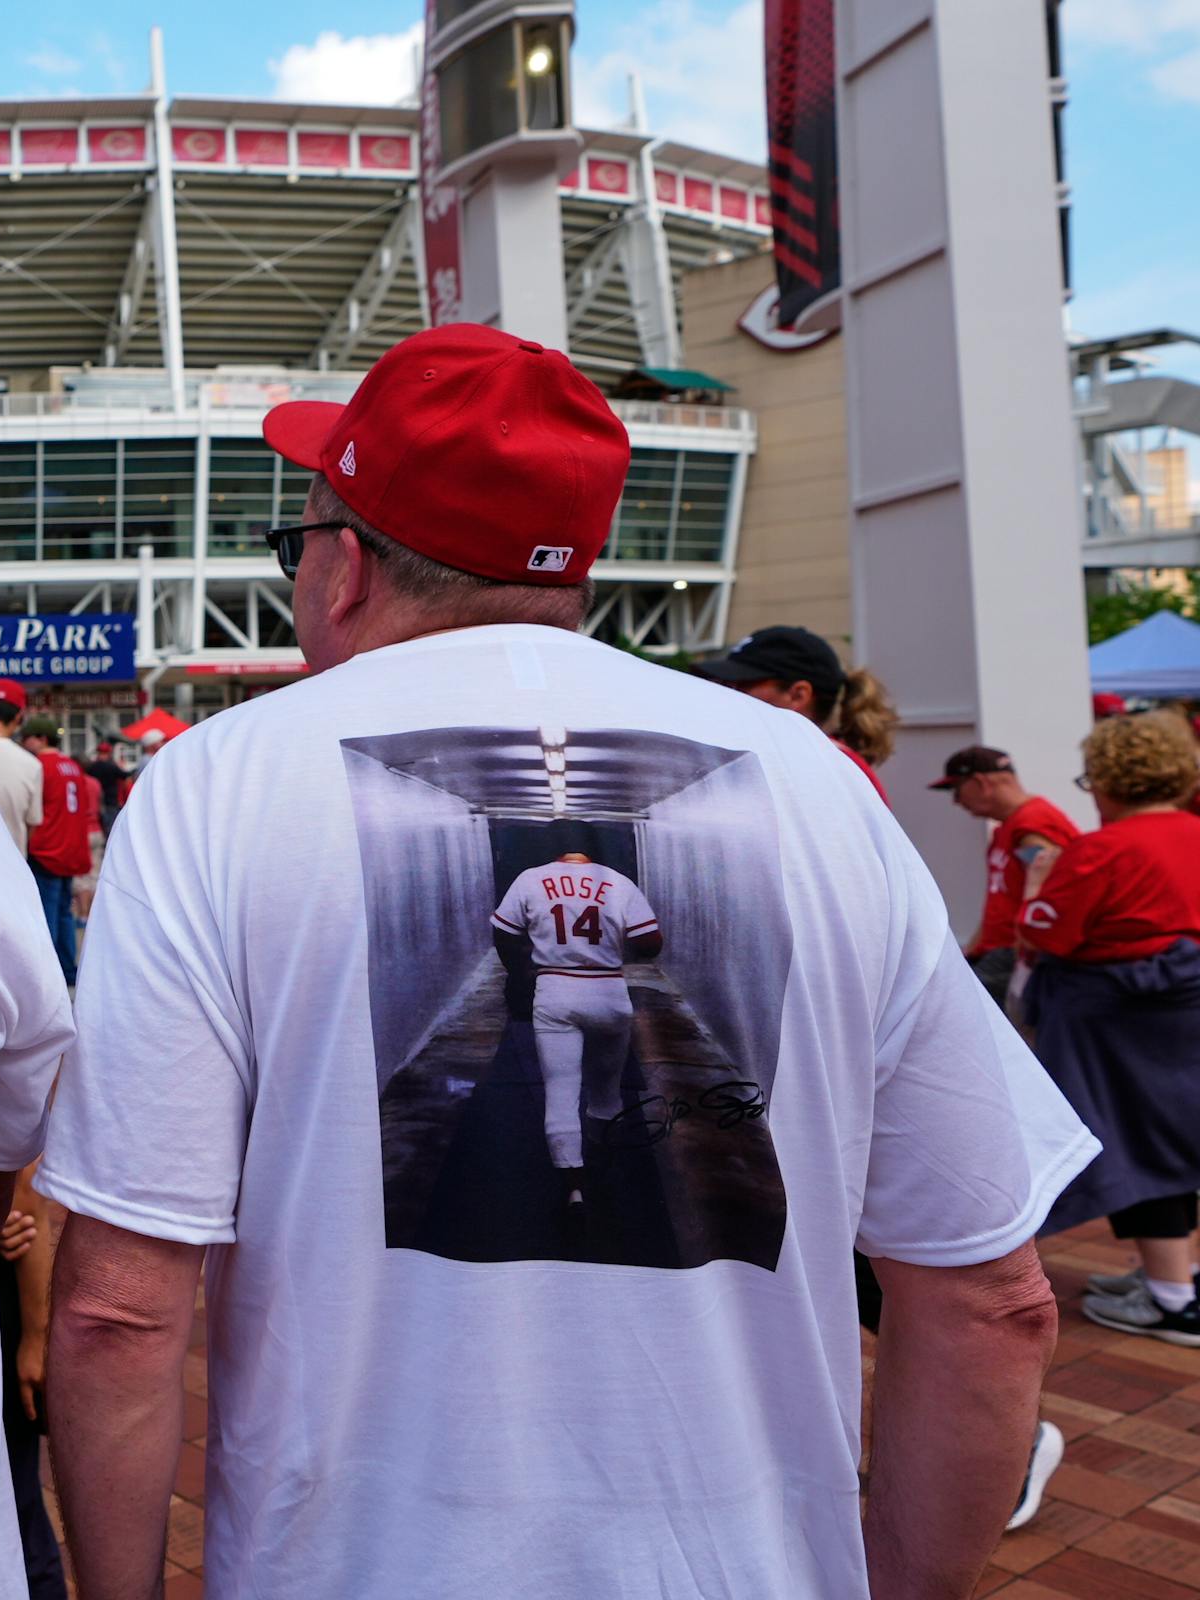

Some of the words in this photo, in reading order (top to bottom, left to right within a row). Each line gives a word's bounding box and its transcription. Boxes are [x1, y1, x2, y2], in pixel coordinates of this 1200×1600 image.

[13, 618, 112, 652] PARK
[50, 655, 114, 675] GROUP
[542, 875, 614, 905] ROSE
[550, 903, 603, 945] 14
